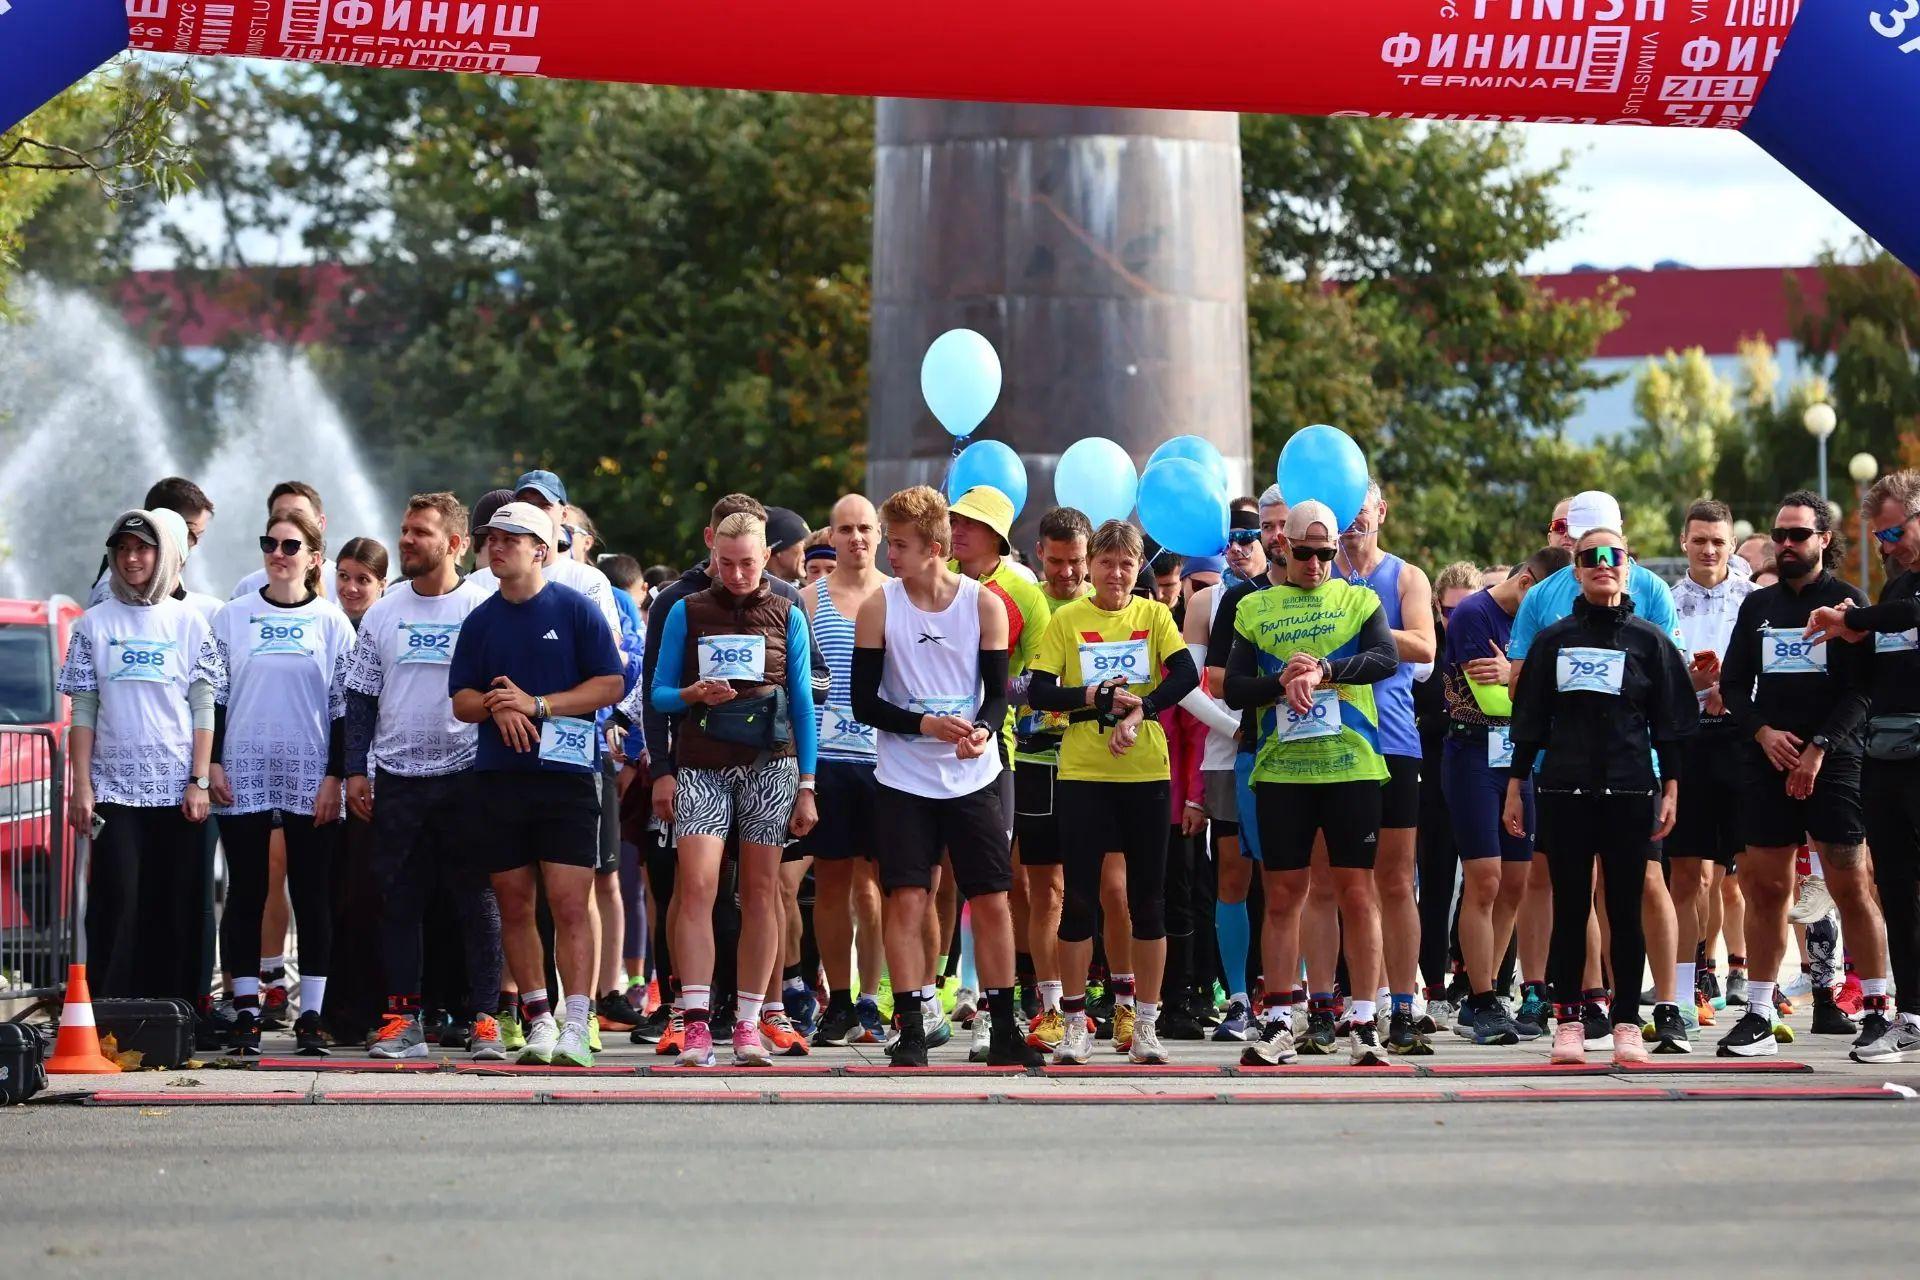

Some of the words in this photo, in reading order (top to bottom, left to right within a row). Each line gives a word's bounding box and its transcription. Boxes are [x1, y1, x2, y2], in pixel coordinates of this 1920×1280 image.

[332, 0, 540, 38] ФИНИШ
[327, 33, 512, 53] TERMINAR
[1381, 32, 1582, 70] ФИНИШ
[1397, 74, 1575, 89] TERMINAR
[1622, 31, 1660, 114] VIIMISTLUS
[1665, 79, 1752, 98] ZIEL
[1260, 607, 1346, 635] Балтийский
[260, 626, 304, 639] 890
[408, 634, 450, 648] 892
[1273, 624, 1335, 646] Марафон
[122, 650, 165, 665] 688
[710, 648, 753, 663] 468
[1774, 642, 1814, 657] 887
[1093, 654, 1136, 670] 870
[1569, 661, 1609, 677] 792
[834, 719, 874, 737] 452
[555, 730, 587, 749] 753
